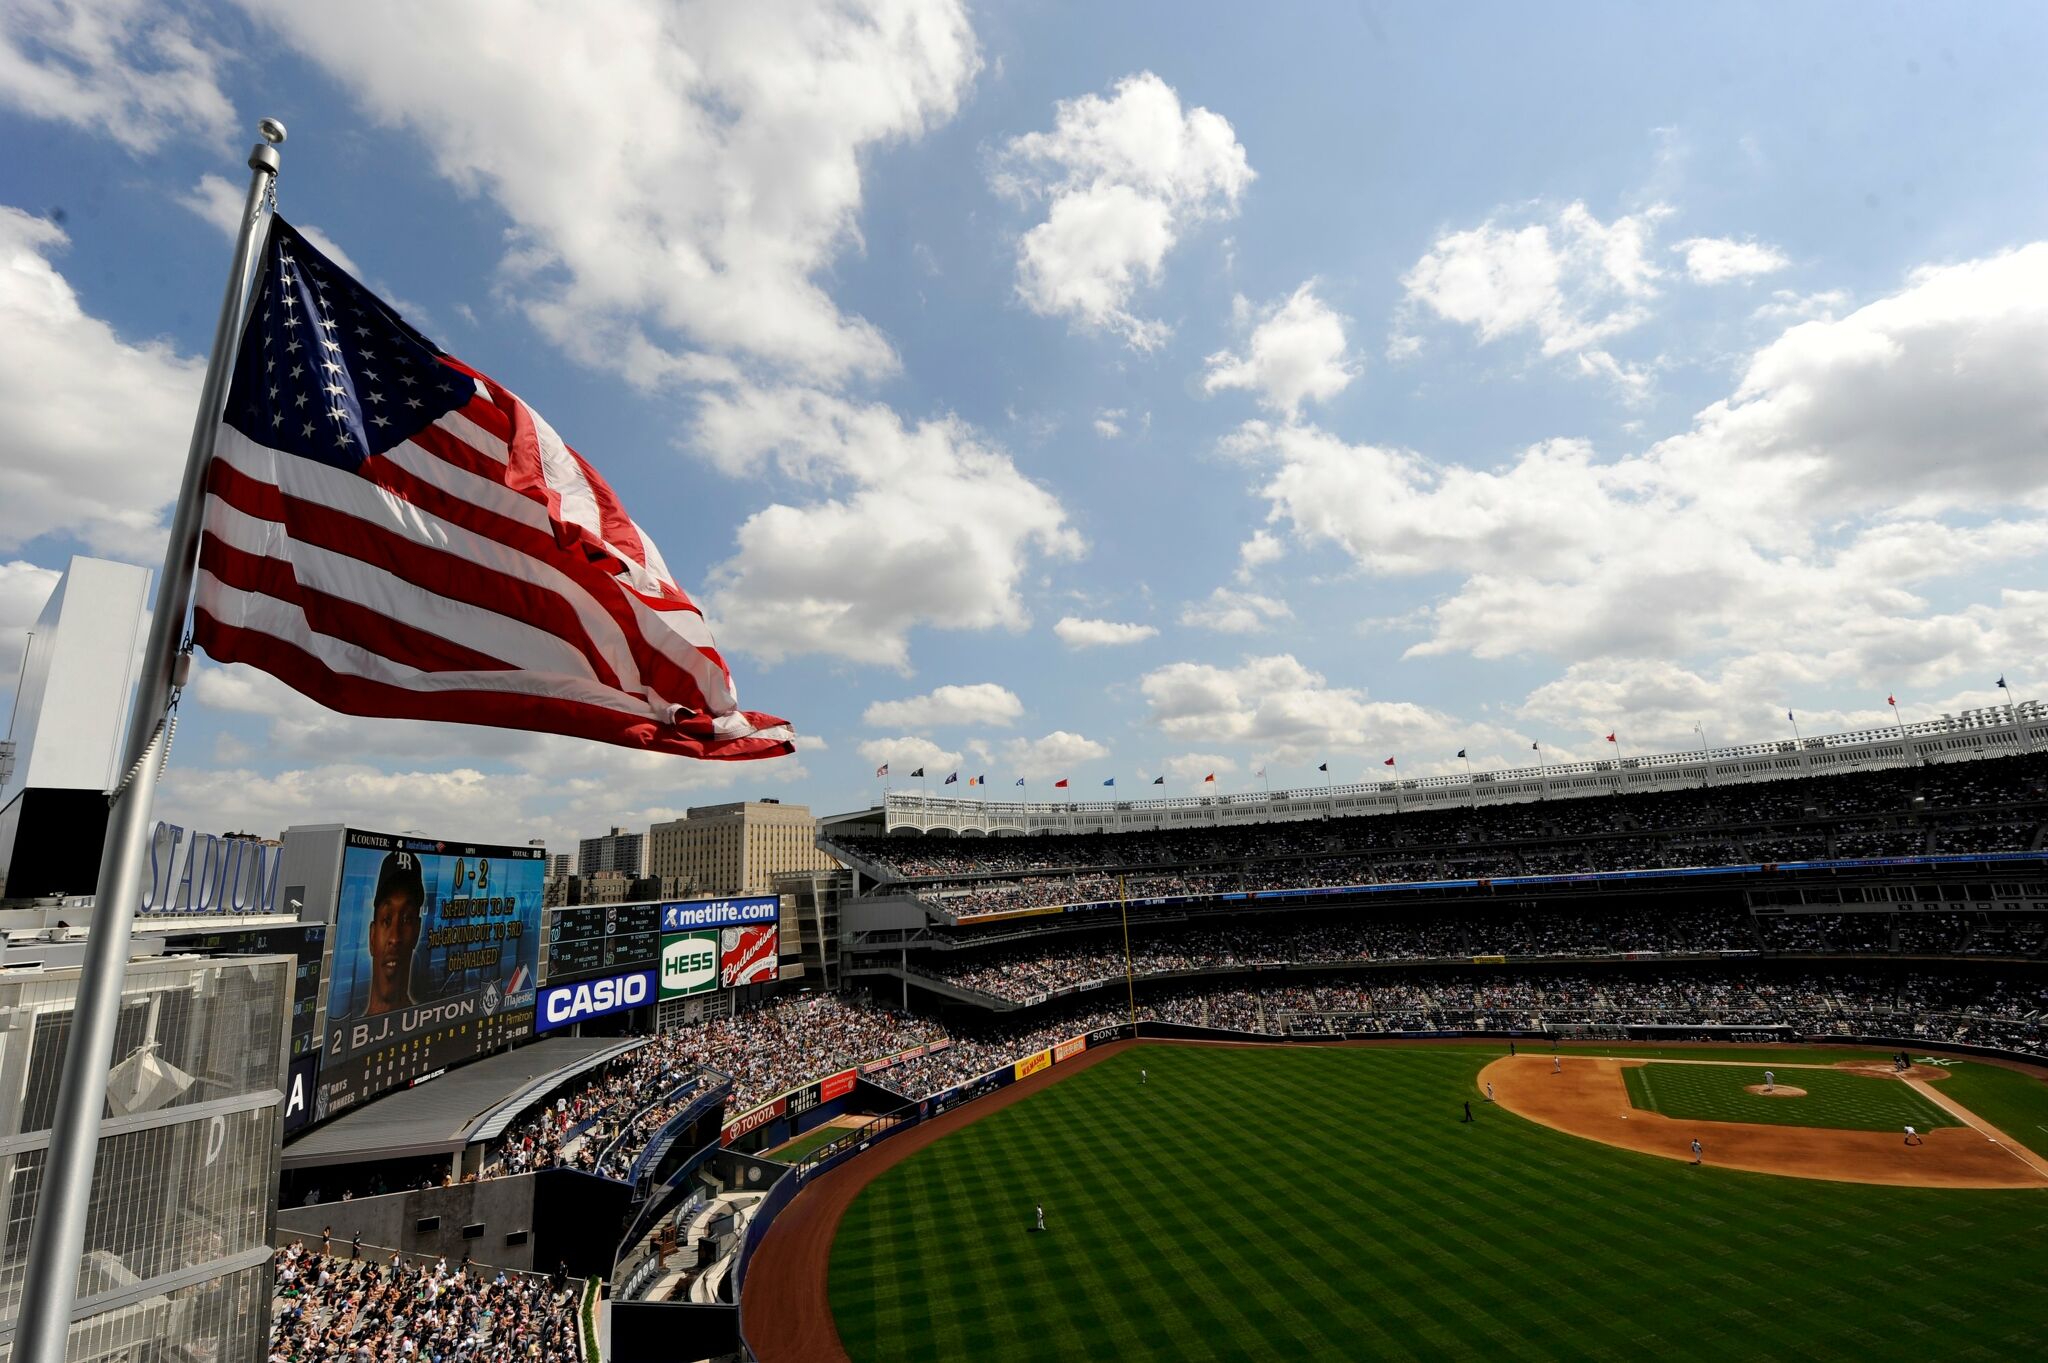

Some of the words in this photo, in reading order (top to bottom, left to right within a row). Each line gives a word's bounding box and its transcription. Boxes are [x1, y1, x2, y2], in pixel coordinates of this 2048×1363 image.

[351, 834, 357, 844] K
[357, 835, 390, 848] COUNTER:
[141, 820, 284, 912] STADIUM
[456, 858, 464, 889] 0
[478, 859, 488, 888] 2
[470, 899, 488, 916] OUT
[490, 898, 502, 916] TO
[680, 902, 774, 926] metlife.com
[494, 924, 505, 940] TO
[507, 922, 522, 938] 3RD
[666, 952, 712, 976] HESS
[721, 924, 777, 988] Budweiser
[504, 992, 533, 1008] Majestic
[547, 974, 646, 1022] CASIO
[506, 1011, 532, 1024] Armitron
[302, 1035, 309, 1052] 2
[332, 1030, 342, 1054] 2
[352, 1018, 394, 1049] B.J.
[1093, 1027, 1120, 1040] SONY
[286, 1073, 304, 1118] A
[330, 1079, 348, 1095] RAYS
[329, 1092, 355, 1112] YANKEES
[795, 1100, 813, 1113] IMAGE
[742, 1105, 775, 1132] TOYOTA
